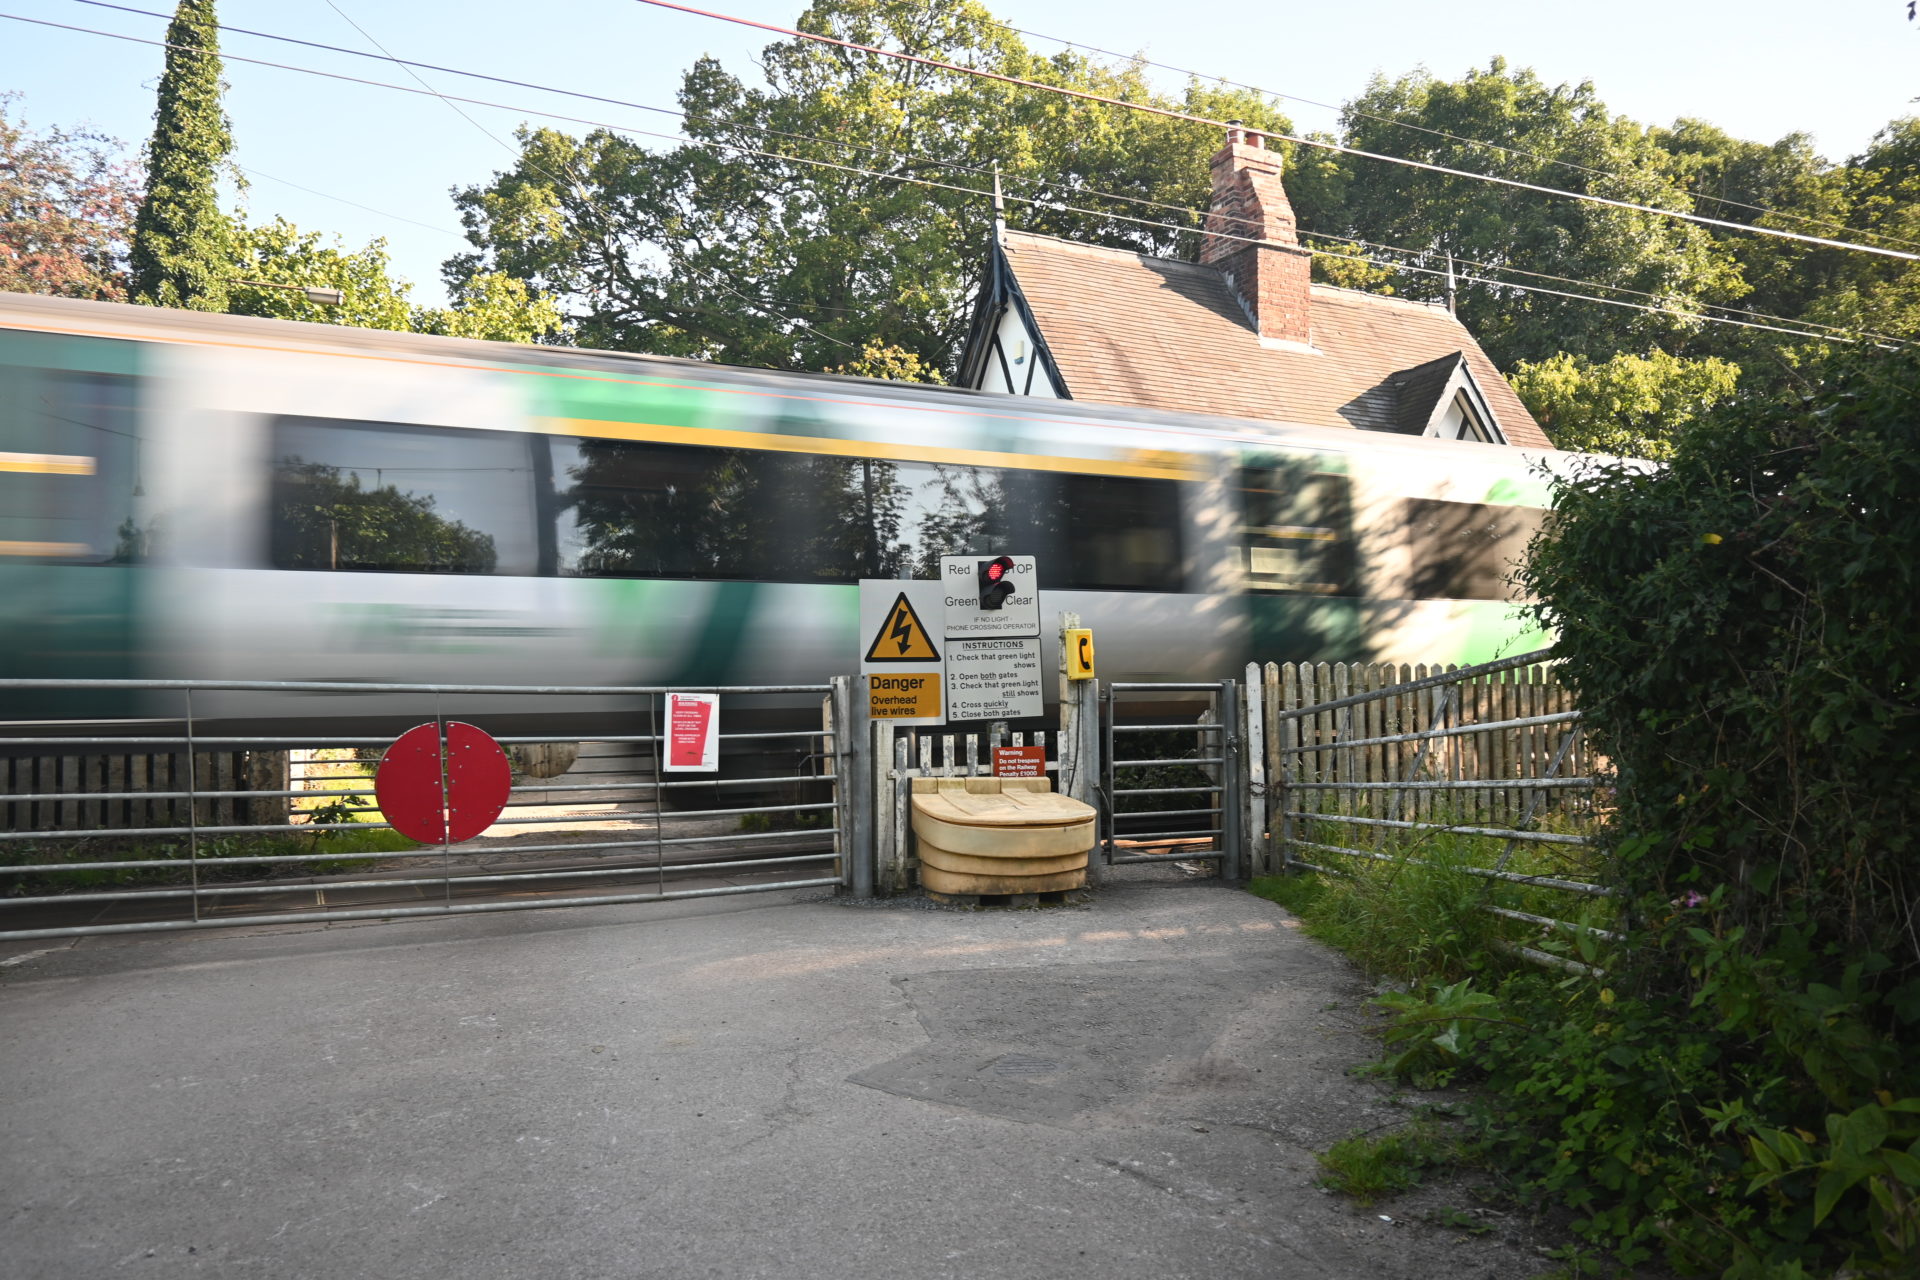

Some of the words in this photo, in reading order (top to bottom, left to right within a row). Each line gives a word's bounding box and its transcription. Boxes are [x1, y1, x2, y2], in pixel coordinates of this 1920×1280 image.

[948, 565, 970, 574] Red
[1005, 564, 1032, 574] TOP
[945, 596, 977, 606] Green
[1006, 596, 1032, 605] Clear
[871, 677, 924, 691] Danger
[871, 696, 917, 704] Overhead
[871, 707, 887, 715] live
[890, 706, 916, 715] wires
